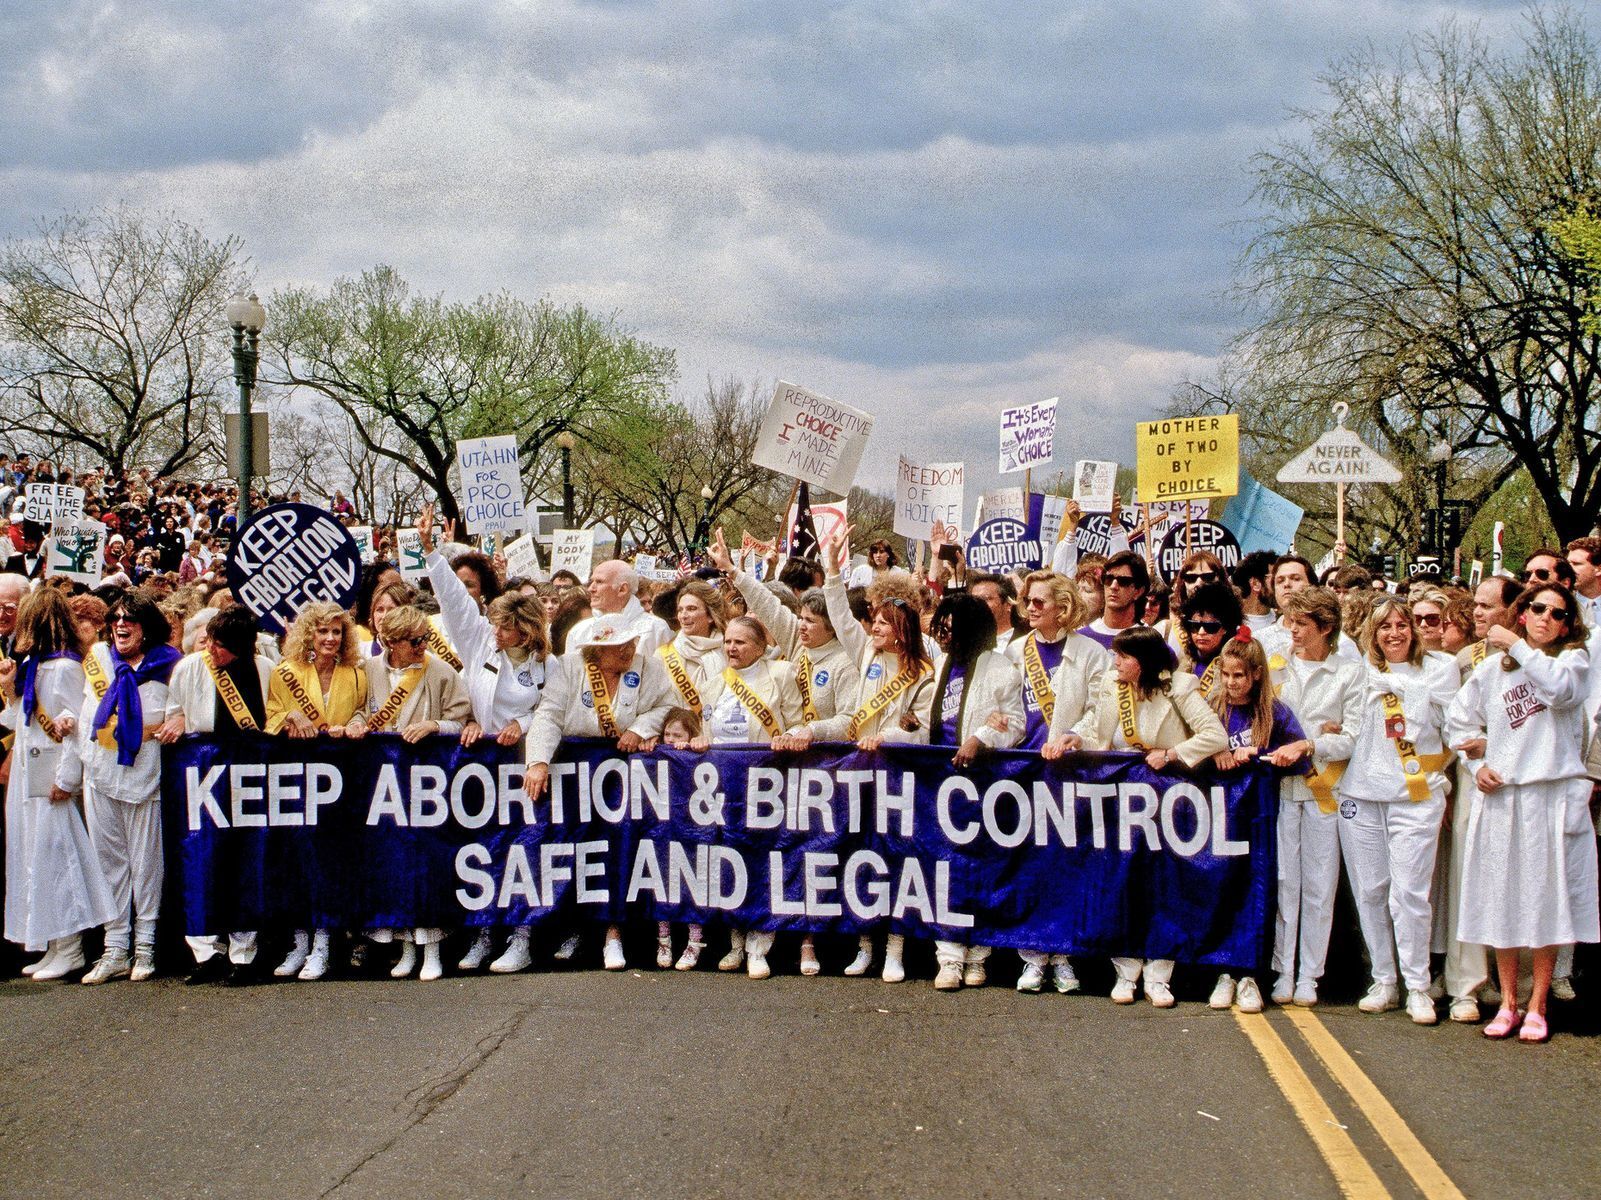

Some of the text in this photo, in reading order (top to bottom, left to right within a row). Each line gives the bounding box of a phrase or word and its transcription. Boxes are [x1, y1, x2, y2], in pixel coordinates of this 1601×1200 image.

[785, 389, 872, 436] REPRODUCTIVE
[1003, 404, 1056, 429] It's Every
[778, 423, 795, 441] I
[1014, 423, 1055, 445] Woman's
[1149, 418, 1219, 436] MOTHER
[462, 447, 517, 468] UTAHN
[1018, 440, 1052, 464] CHOICE
[1157, 439, 1218, 456] OF TWO
[1316, 446, 1361, 459] NEVER
[787, 450, 831, 479] MINE
[898, 460, 963, 486] FREEDOM
[1172, 460, 1191, 473] BY
[1306, 461, 1370, 475] AGAIN!
[475, 470, 500, 483] FOR
[1158, 478, 1215, 494] CHOICE
[29, 496, 80, 508] ALL THE
[31, 484, 75, 498] FREE
[468, 483, 511, 503] PRO
[908, 486, 932, 502] OF
[466, 501, 523, 523] CHOICE
[234, 509, 298, 577] KEEP
[565, 535, 580, 543] MY
[980, 521, 1025, 545] KEEP
[1174, 523, 1225, 548] KEEP
[557, 545, 586, 554] BODY
[970, 540, 1039, 568] ABORTION
[238, 516, 347, 617] ABORTION
[665, 652, 700, 706] HONORED
[277, 665, 320, 721] HONORED
[731, 679, 774, 727] HONORED
[1502, 682, 1529, 704] VOICES
[368, 686, 408, 732] HONORE
[1506, 703, 1525, 721] FOR
[185, 757, 1250, 858] KEEP ABORTION & BIRTH CONTROL
[455, 838, 974, 928] SAFE AND LEGAL
